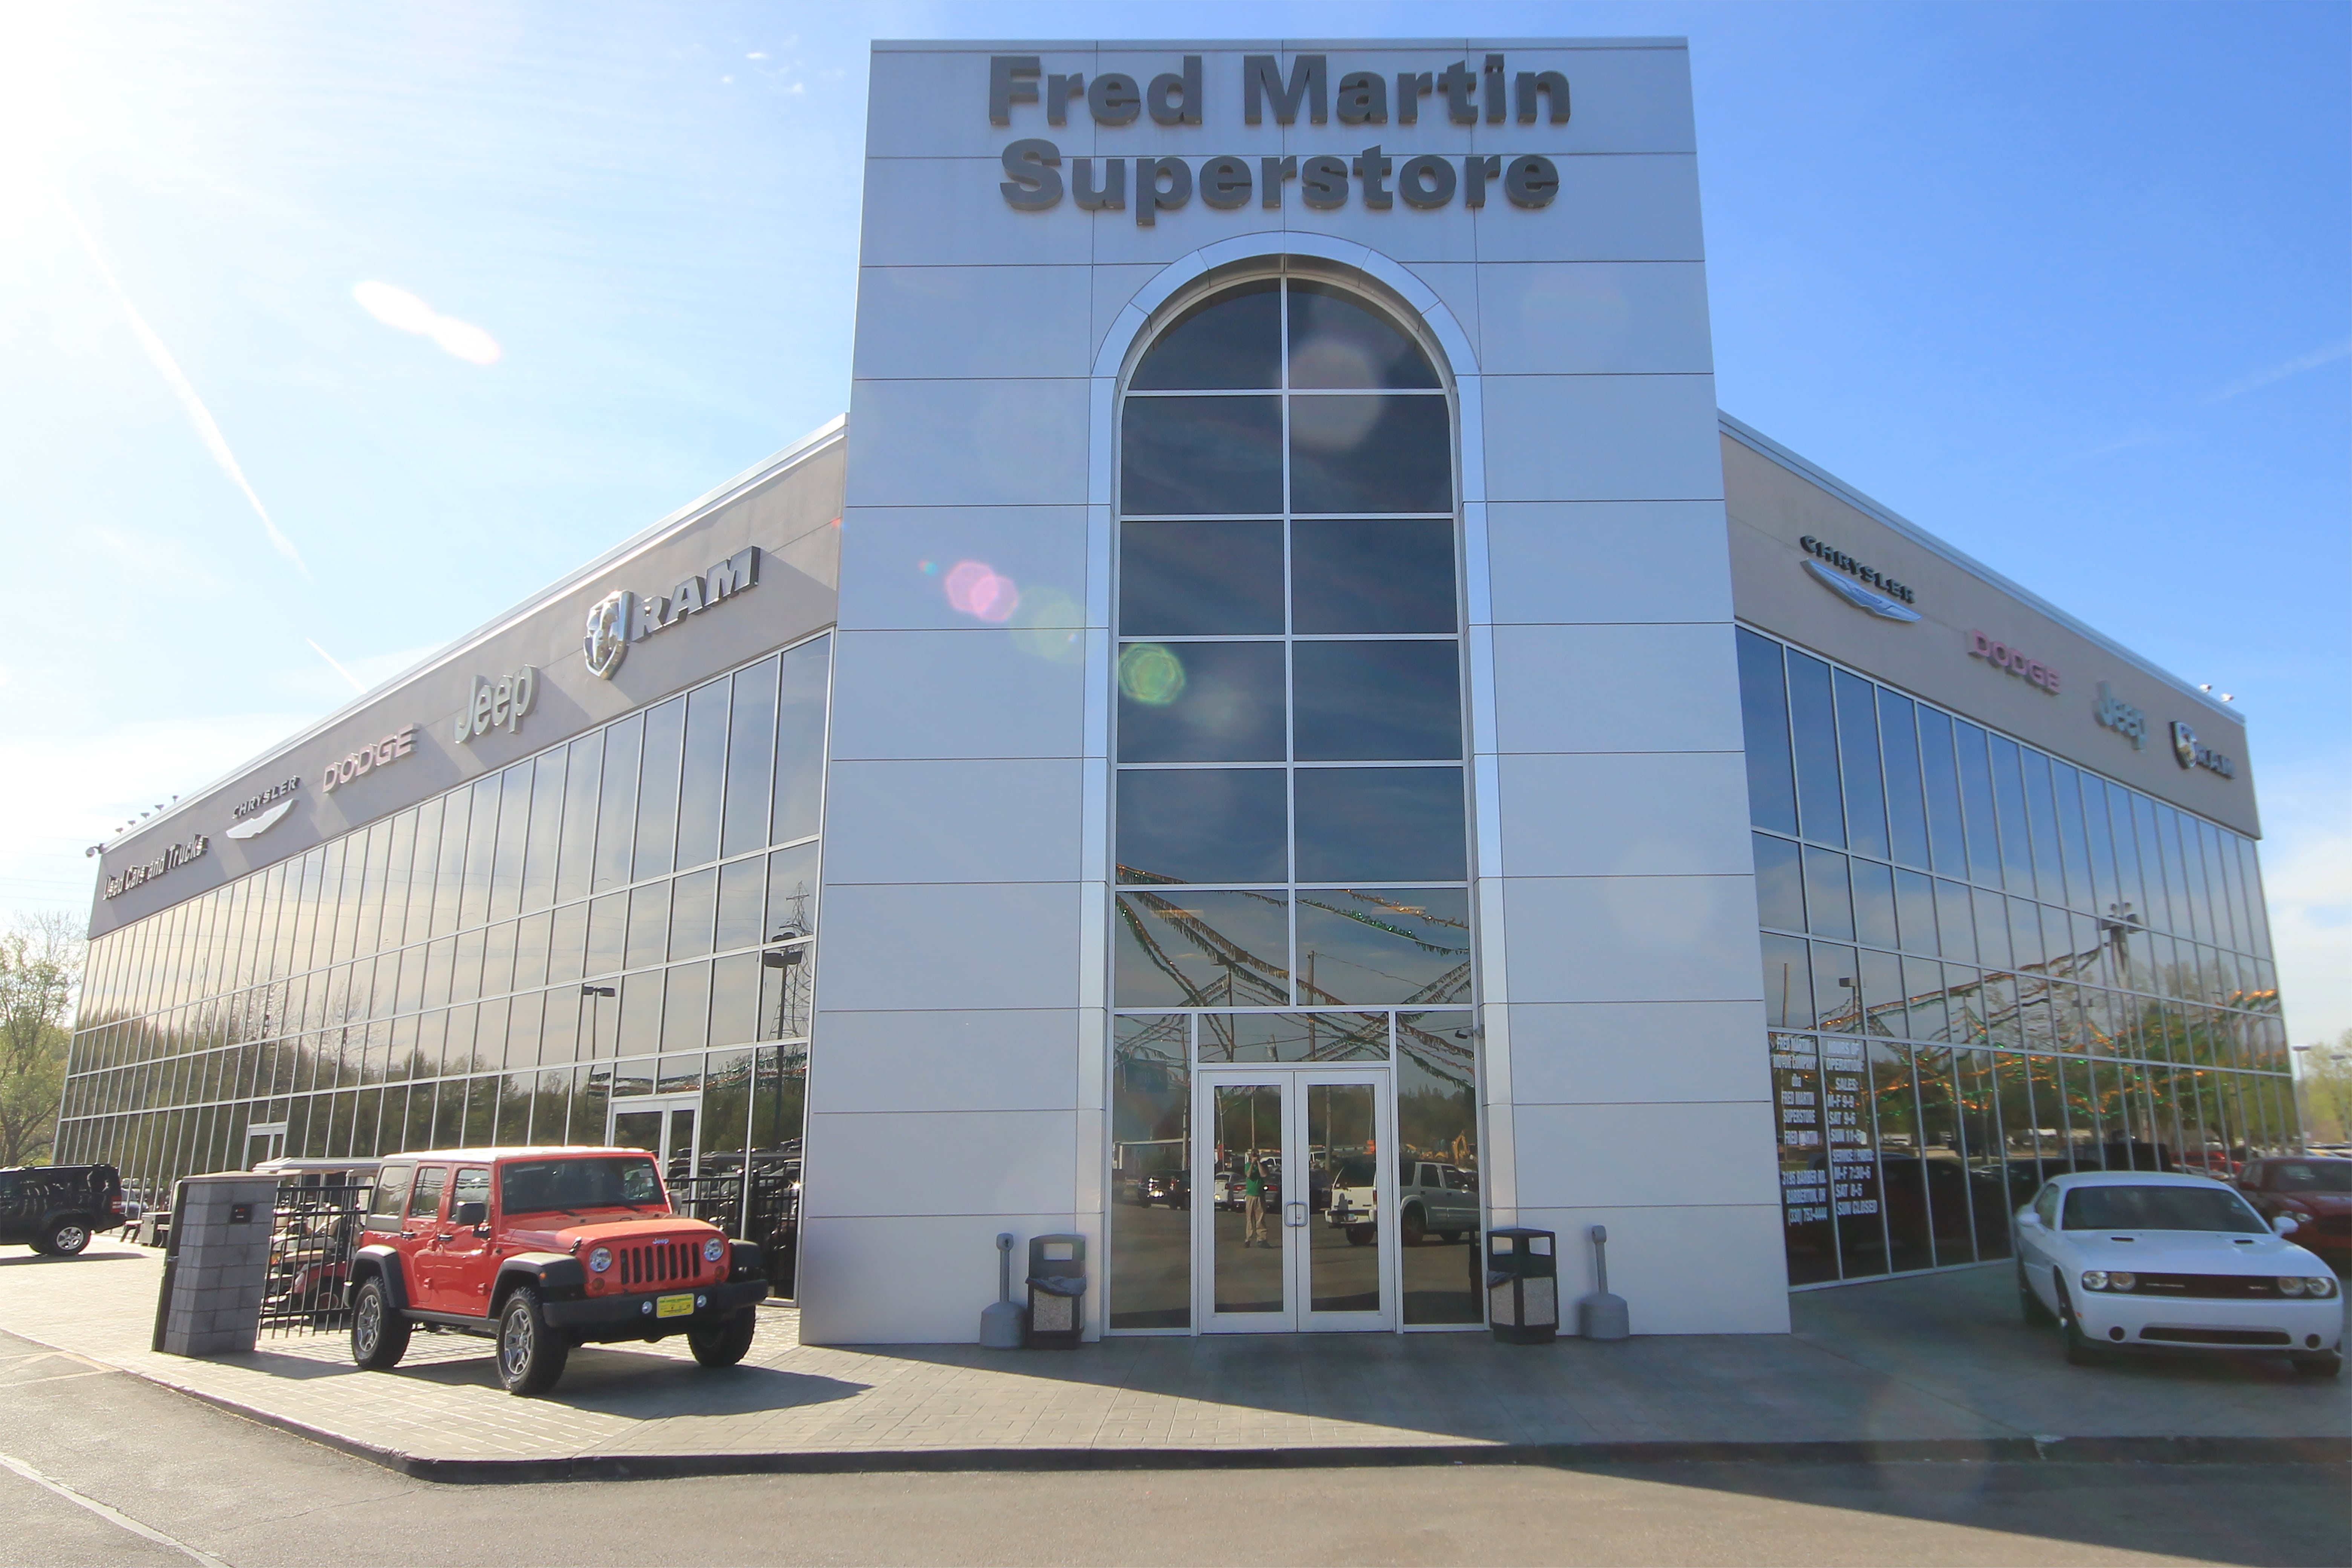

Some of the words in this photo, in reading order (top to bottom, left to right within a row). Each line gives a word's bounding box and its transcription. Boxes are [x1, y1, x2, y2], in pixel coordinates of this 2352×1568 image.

[989, 55, 1203, 126] Fred
[1243, 54, 1571, 125] Martin
[1000, 138, 1560, 227] Superstore
[631, 546, 761, 643] RAM
[1800, 535, 1915, 603] CHRYSLER
[1965, 628, 2061, 695] DODGE
[455, 664, 539, 744] Jeep
[2092, 680, 2147, 753] Jeep
[322, 723, 420, 794] DODGE
[232, 775, 300, 819] CHRYSLER
[103, 870, 126, 900] Used
[125, 865, 148, 890] Cars
[147, 849, 168, 880] and
[168, 834, 208, 870] Trucks
[1828, 1111, 1842, 1125] SAT
[1836, 1184, 1848, 1197] SAT
